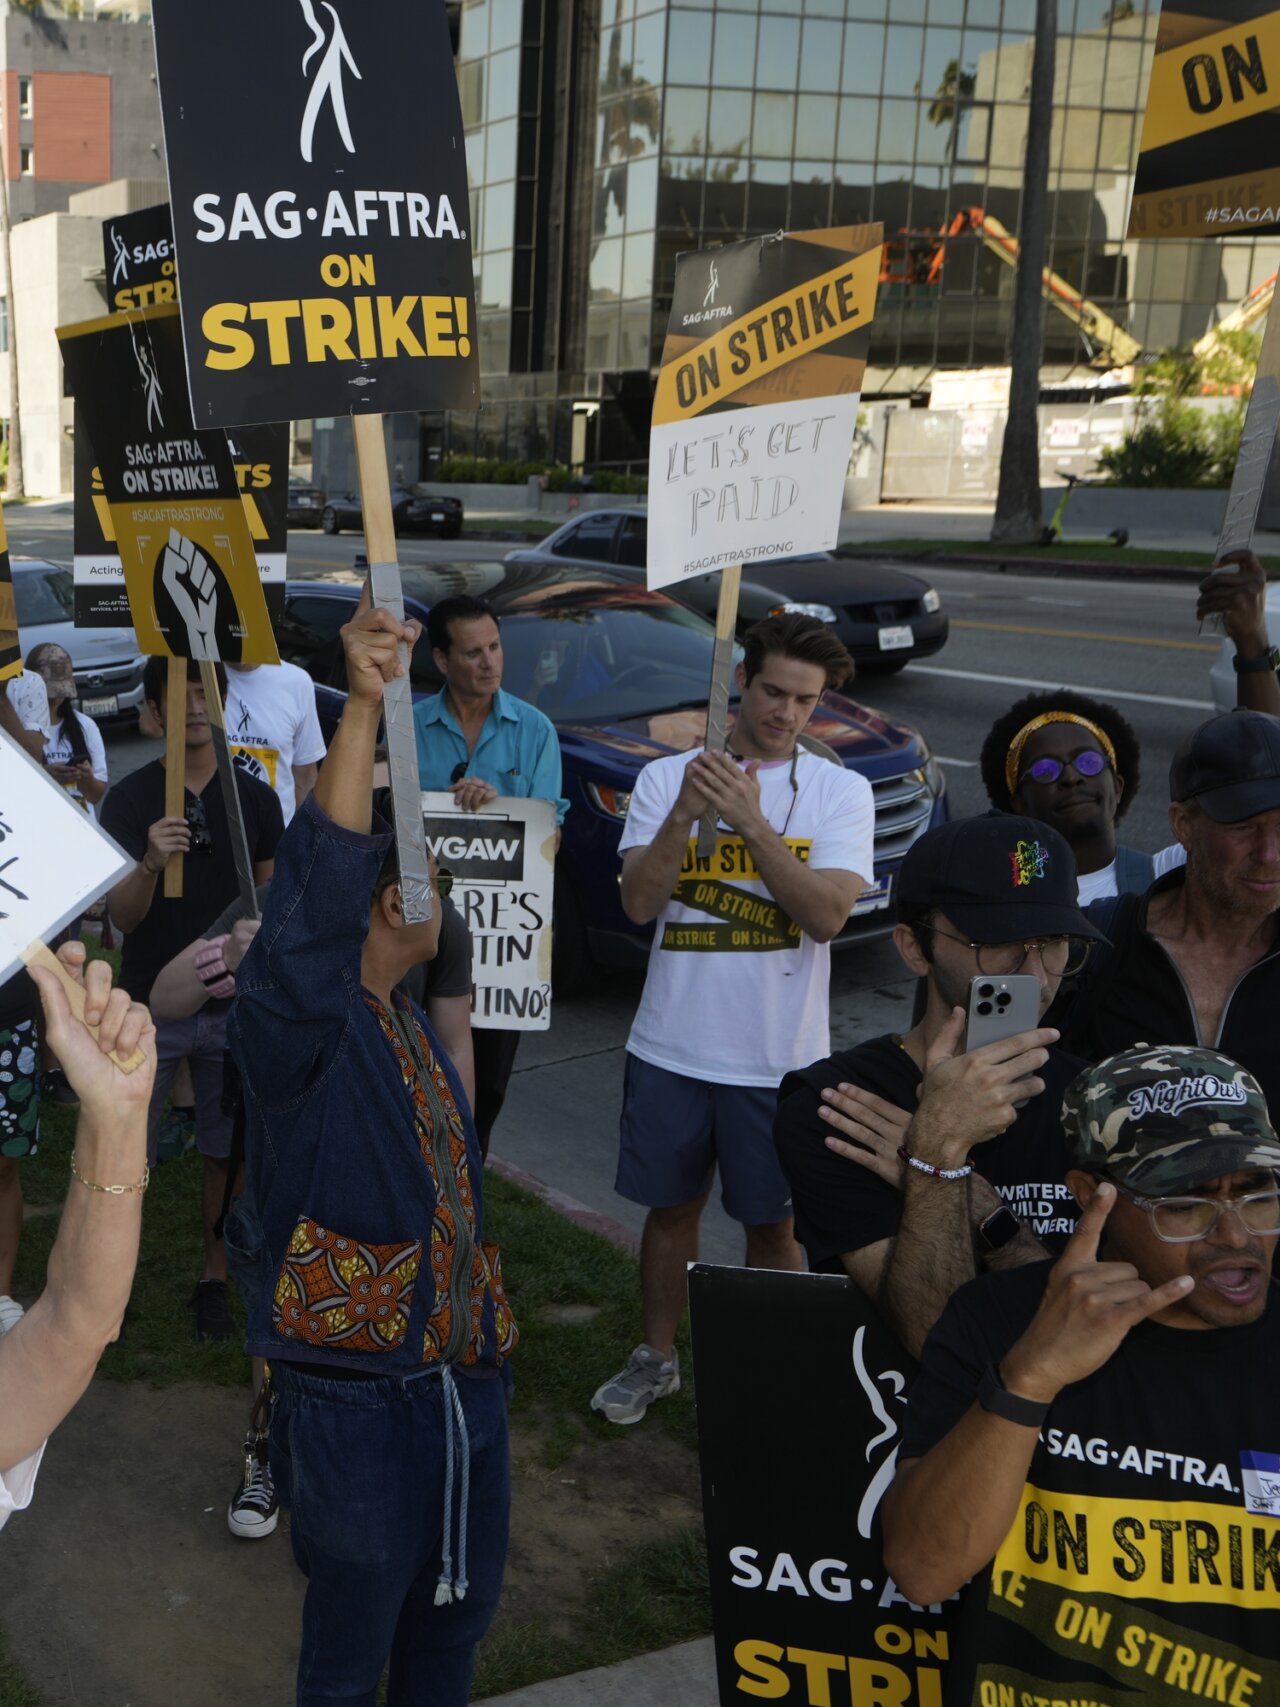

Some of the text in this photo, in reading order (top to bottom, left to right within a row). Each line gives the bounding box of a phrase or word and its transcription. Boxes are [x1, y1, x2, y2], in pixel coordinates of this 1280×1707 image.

[1182, 35, 1268, 115] ON
[192, 190, 465, 243] SAG·AFTRA
[320, 253, 376, 288] ON
[201, 295, 471, 371] STRIKE!
[682, 305, 733, 326] SAG·AFTRA
[675, 273, 860, 408] ON STRIKE
[125, 439, 204, 466] SAG·AFTRA
[665, 415, 836, 485] LET'S GET
[123, 472, 149, 494] ON
[151, 465, 219, 493] STRIKE!
[132, 506, 225, 523] #SAGAFTRASTRONG
[687, 475, 806, 537] PAID.
[90, 566, 124, 576] Acting
[683, 541, 794, 573] #SAGAFTRASTRONG
[694, 883, 717, 905] ON
[719, 893, 777, 929] STRIKE
[676, 931, 716, 945] STRIKE
[732, 931, 750, 945] ON
[1128, 1075, 1246, 1120] NightOwl
[1016, 1201, 1053, 1219] UILD
[1046, 1428, 1236, 1493] SAG·AFTRA
[1025, 1501, 1089, 1575] ON
[1112, 1517, 1280, 1592] STRIK
[874, 1624, 949, 1661] ON
[1055, 1599, 1263, 1706] ON STRIKE
[733, 1639, 943, 1707] STRI
